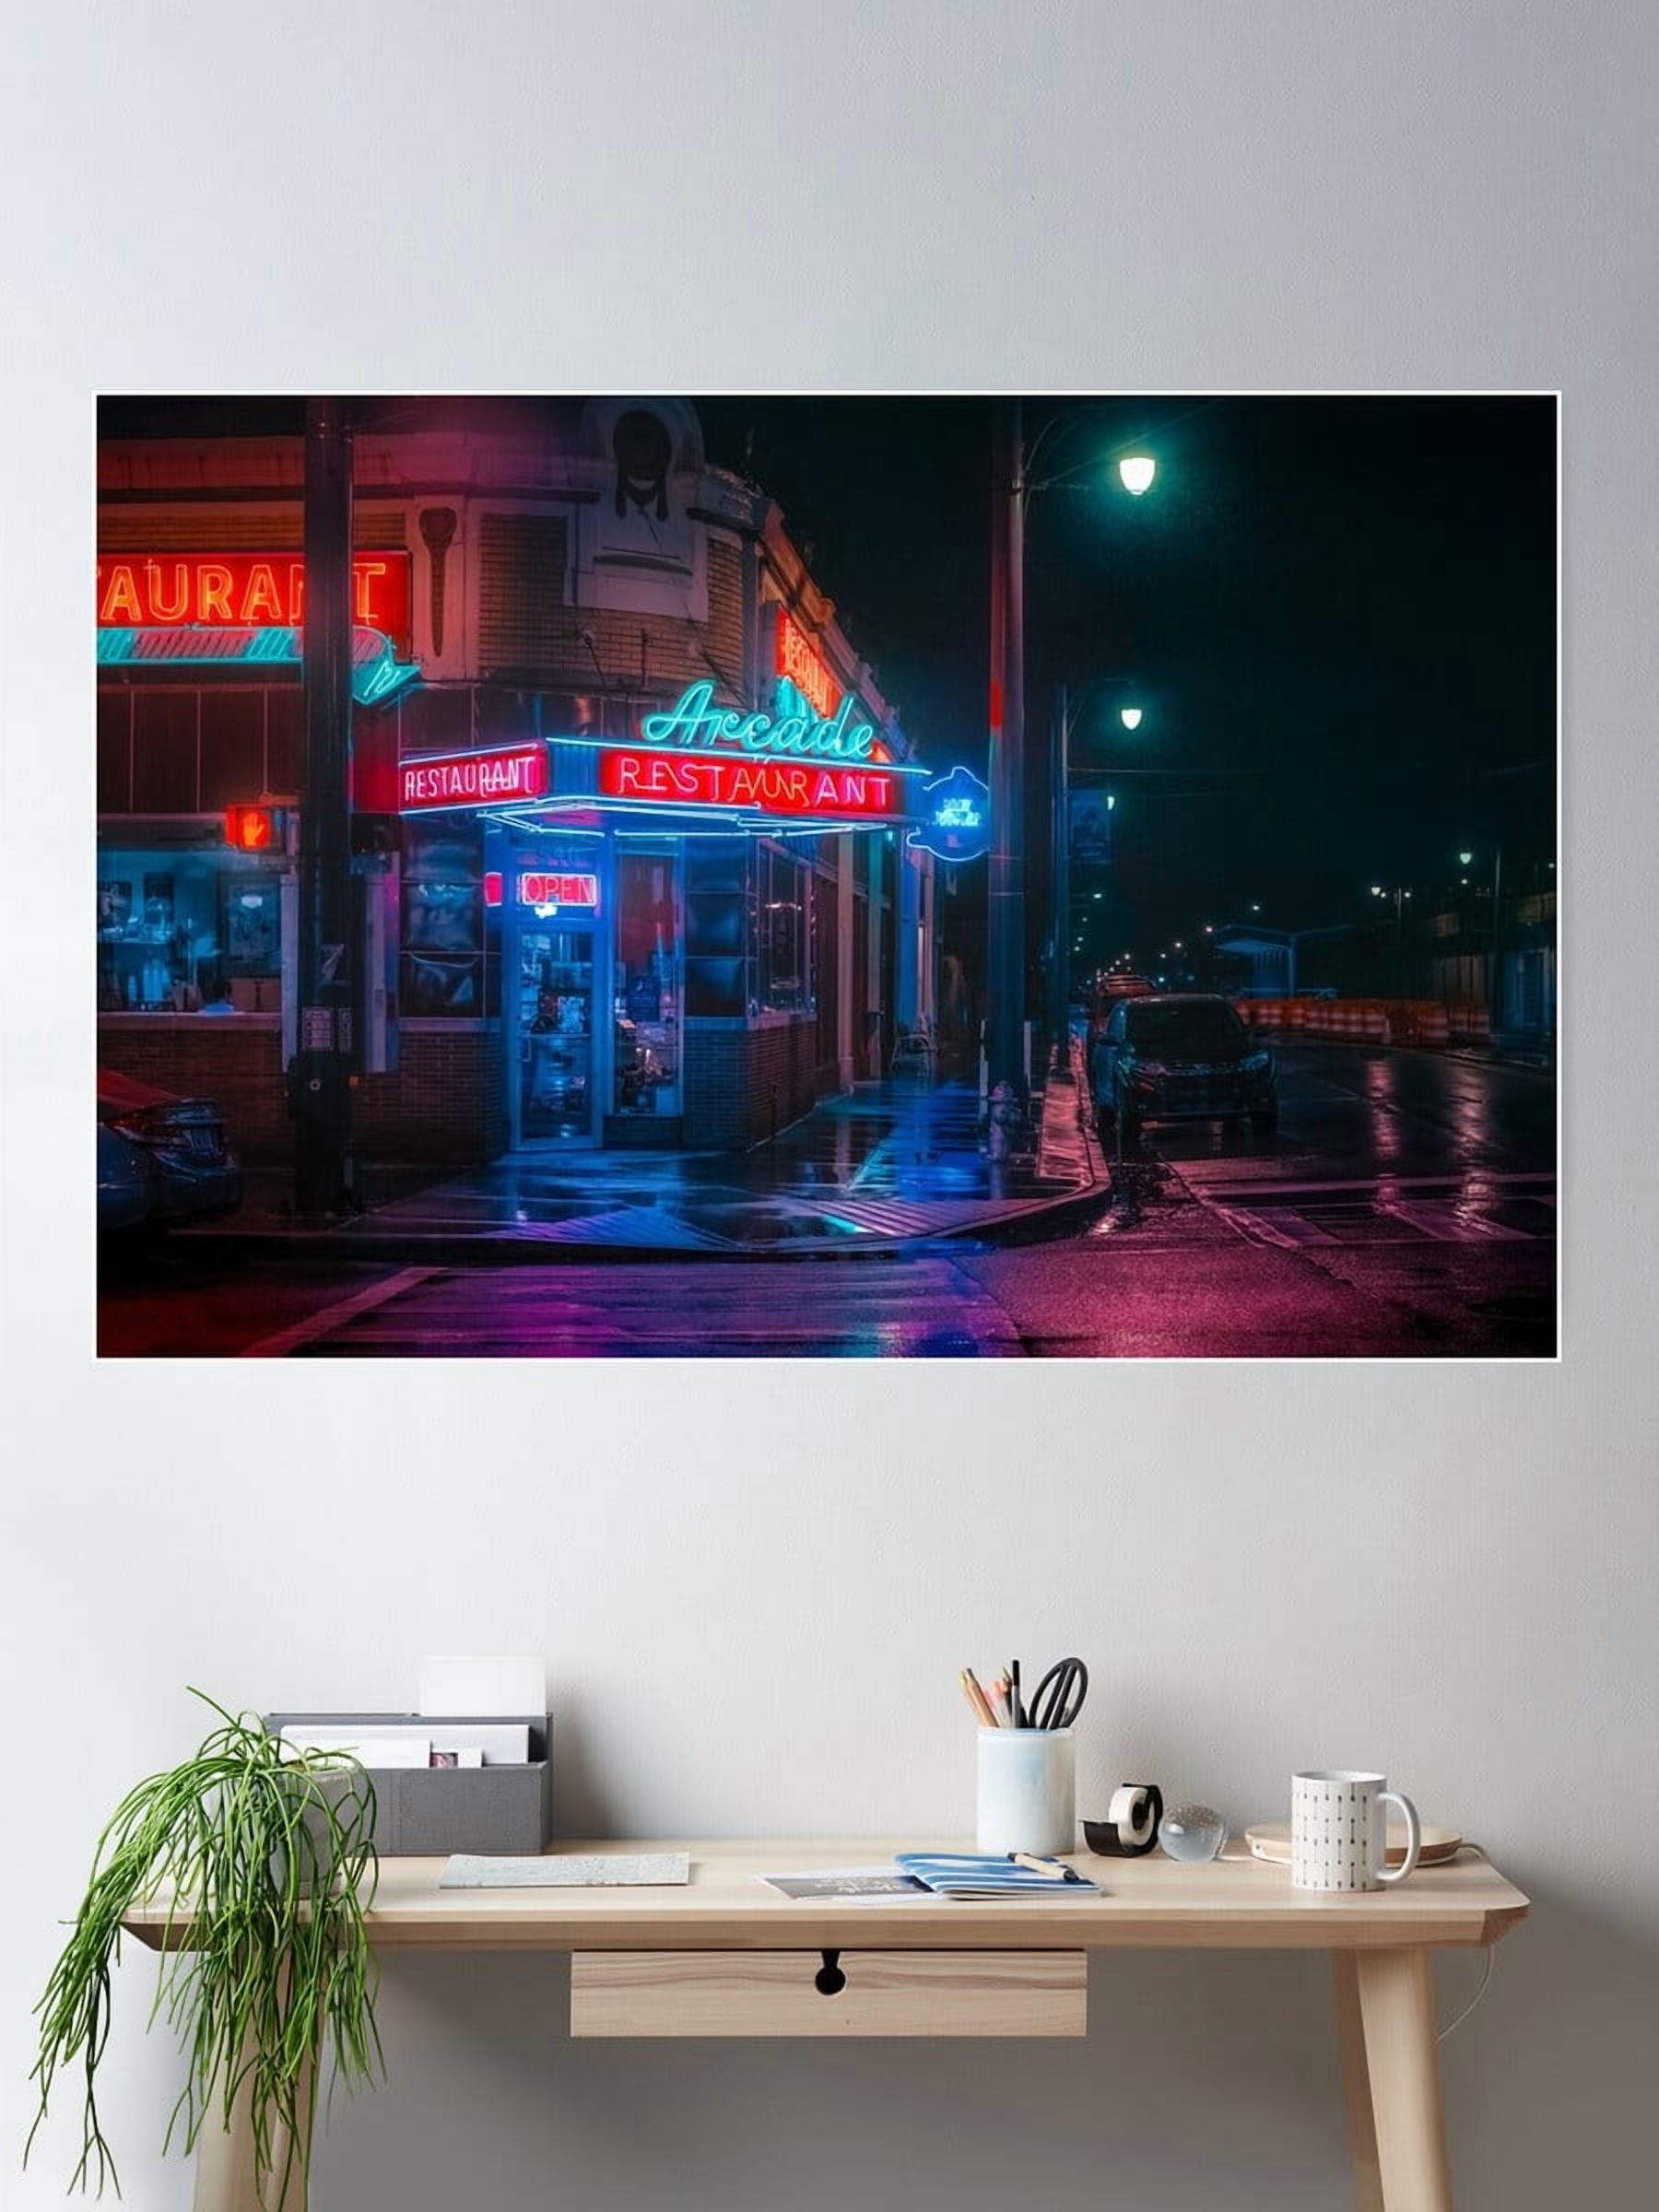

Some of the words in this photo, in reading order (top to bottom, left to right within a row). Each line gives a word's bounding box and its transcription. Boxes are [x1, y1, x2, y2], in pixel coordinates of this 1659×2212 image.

[97, 562, 387, 621] AURAT
[642, 679, 874, 759] Arcade
[405, 756, 535, 800] RESTAURANT
[618, 758, 891, 807] RESTAURANT
[525, 876, 594, 903] OPEN
